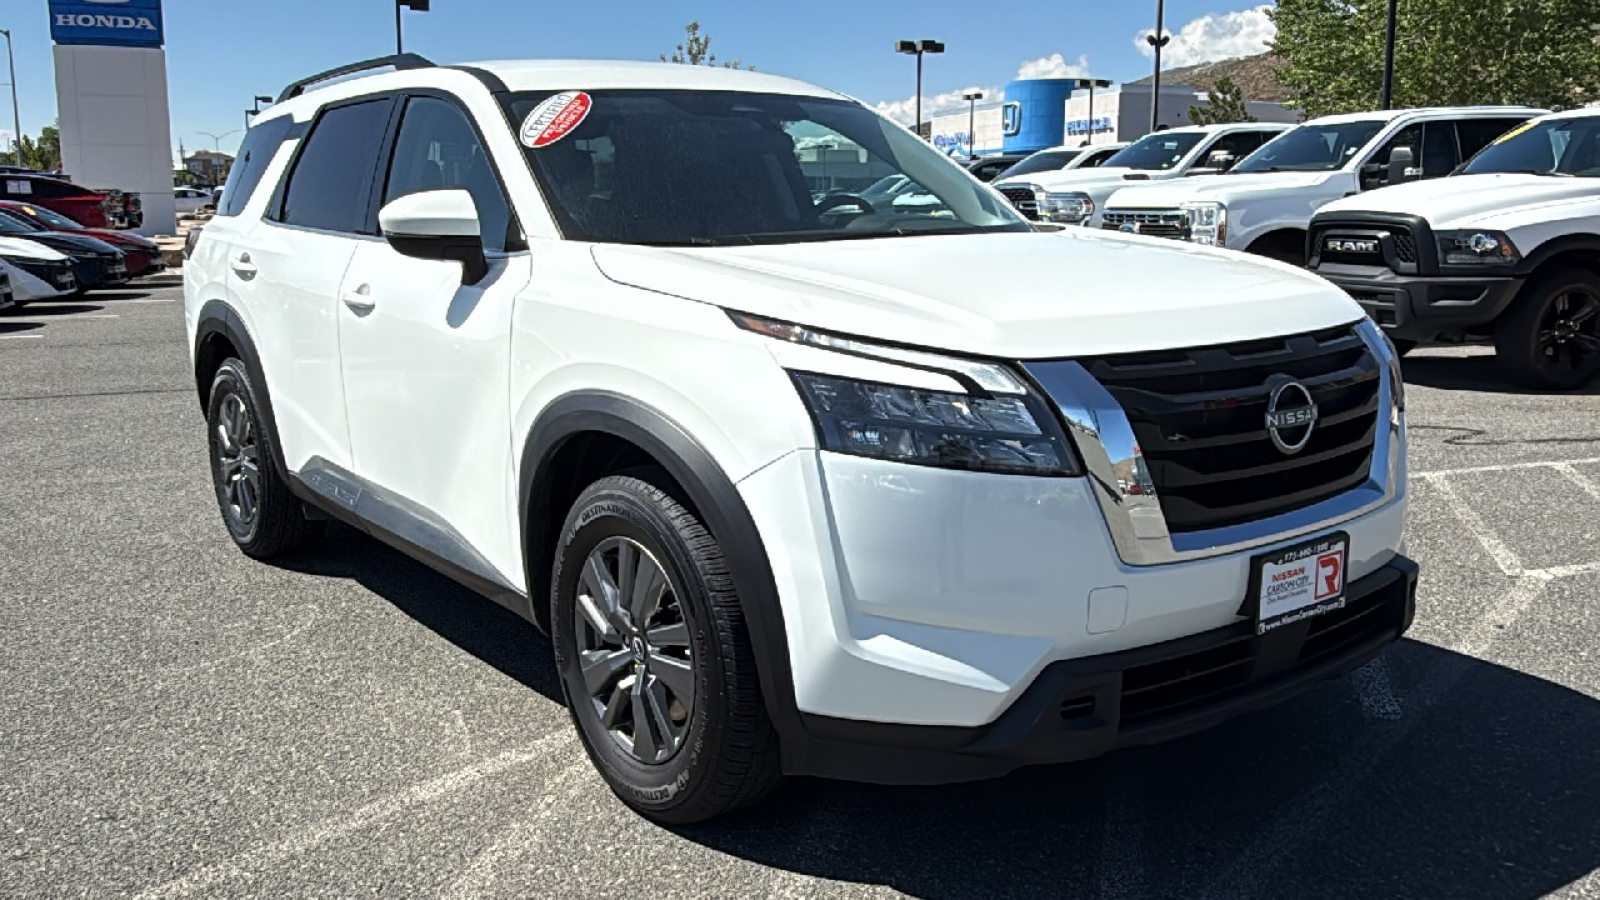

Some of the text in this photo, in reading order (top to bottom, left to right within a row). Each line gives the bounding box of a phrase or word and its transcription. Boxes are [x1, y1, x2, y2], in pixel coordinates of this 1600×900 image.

[55, 14, 157, 30] HONDA
[1328, 241, 1375, 251] RAM
[581, 503, 632, 523] DESTINATION
[1272, 567, 1305, 581] NISSAN
[1266, 575, 1309, 595] CARSON CITY
